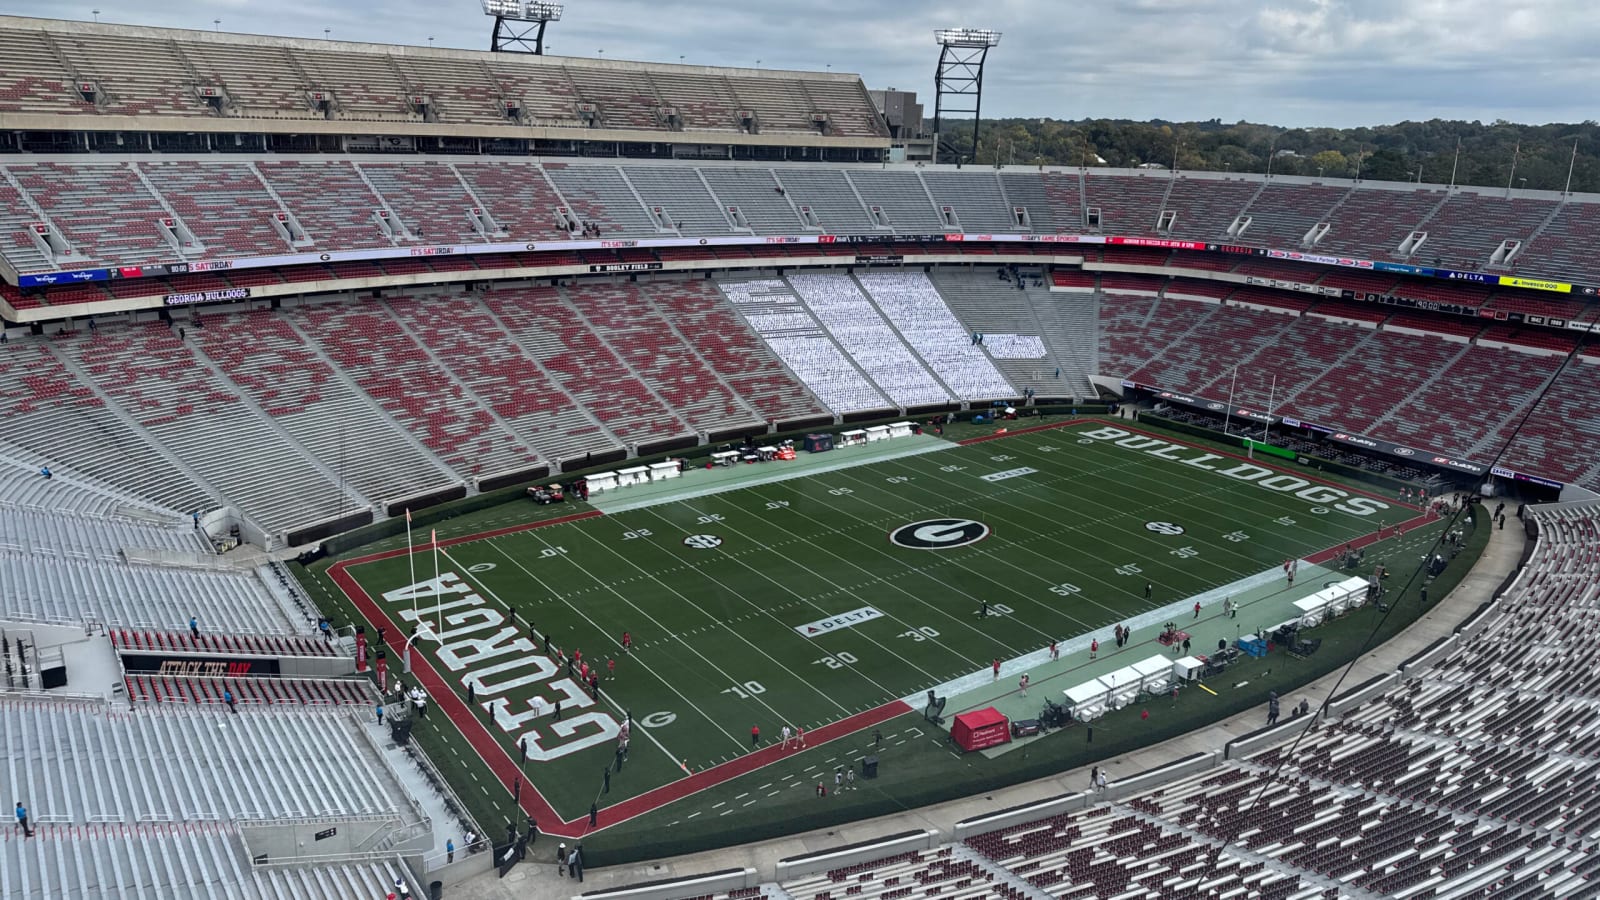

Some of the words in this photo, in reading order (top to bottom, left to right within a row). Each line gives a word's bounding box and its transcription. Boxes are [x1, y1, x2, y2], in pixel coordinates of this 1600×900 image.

[423, 247, 454, 255] SATURDAY
[195, 261, 233, 270] SATURDAY
[1457, 272, 1484, 281] DELTA
[168, 293, 203, 305] GEORGIA
[206, 289, 246, 301] BULLDOGS
[1079, 426, 1389, 516] BULLDOGS
[903, 519, 986, 546] G
[684, 534, 723, 549] SEC
[1170, 546, 1199, 559] 30
[1114, 563, 1143, 576] 40
[1049, 583, 1081, 596] 50
[985, 603, 1014, 617] 40
[821, 608, 877, 629] DELTA
[906, 626, 940, 642] 30
[381, 571, 622, 762] GEORGIA
[820, 651, 858, 669] 20
[159, 661, 202, 676] ATTACK
[203, 662, 227, 677] THE
[228, 663, 251, 677] DAY
[732, 680, 766, 699] 10
[640, 711, 677, 728] G
